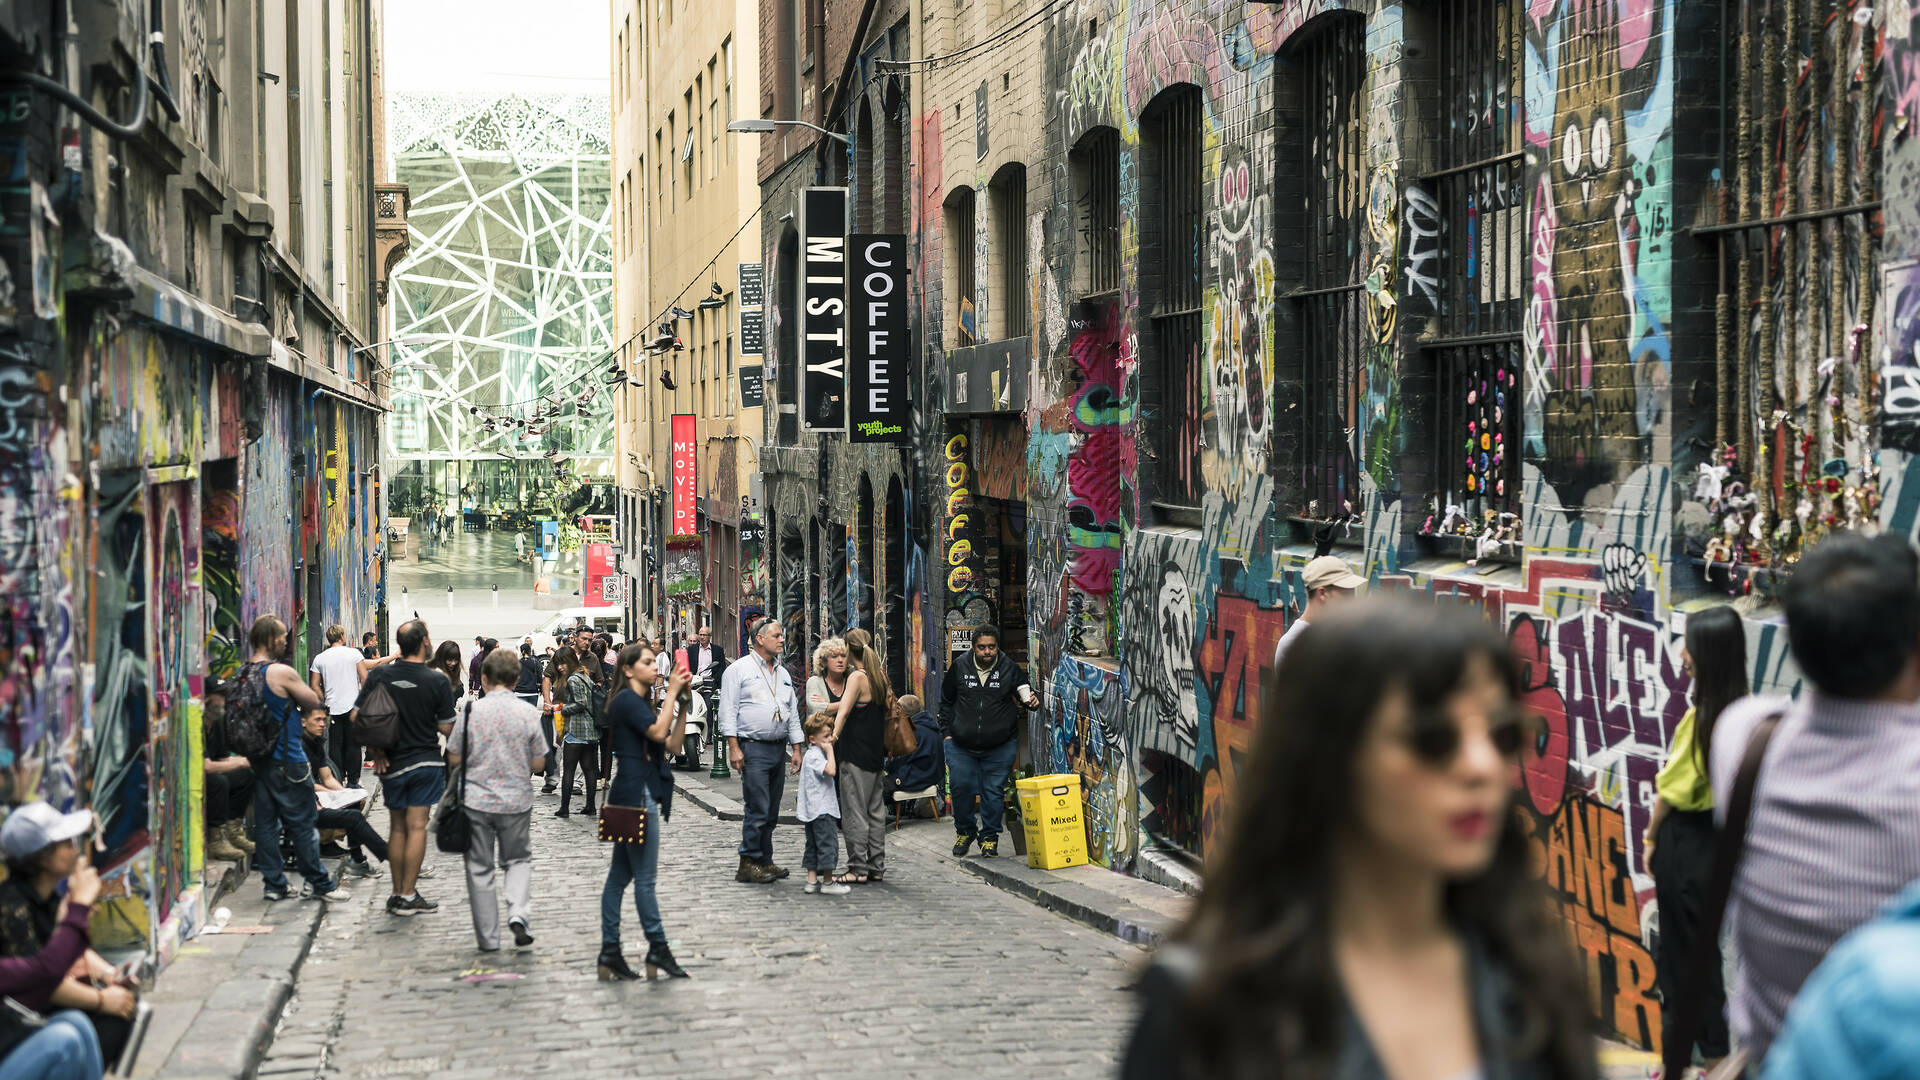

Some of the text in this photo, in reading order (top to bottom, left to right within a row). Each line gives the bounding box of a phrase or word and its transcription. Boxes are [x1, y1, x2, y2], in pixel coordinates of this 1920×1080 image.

[501, 307, 535, 318] WELCME
[806, 236, 844, 379] MISTY
[863, 241, 894, 413] COFFEE
[857, 420, 883, 432] youth
[866, 424, 902, 436] projects
[674, 441, 686, 535] MOVIDA
[1050, 814, 1077, 825] Mixed
